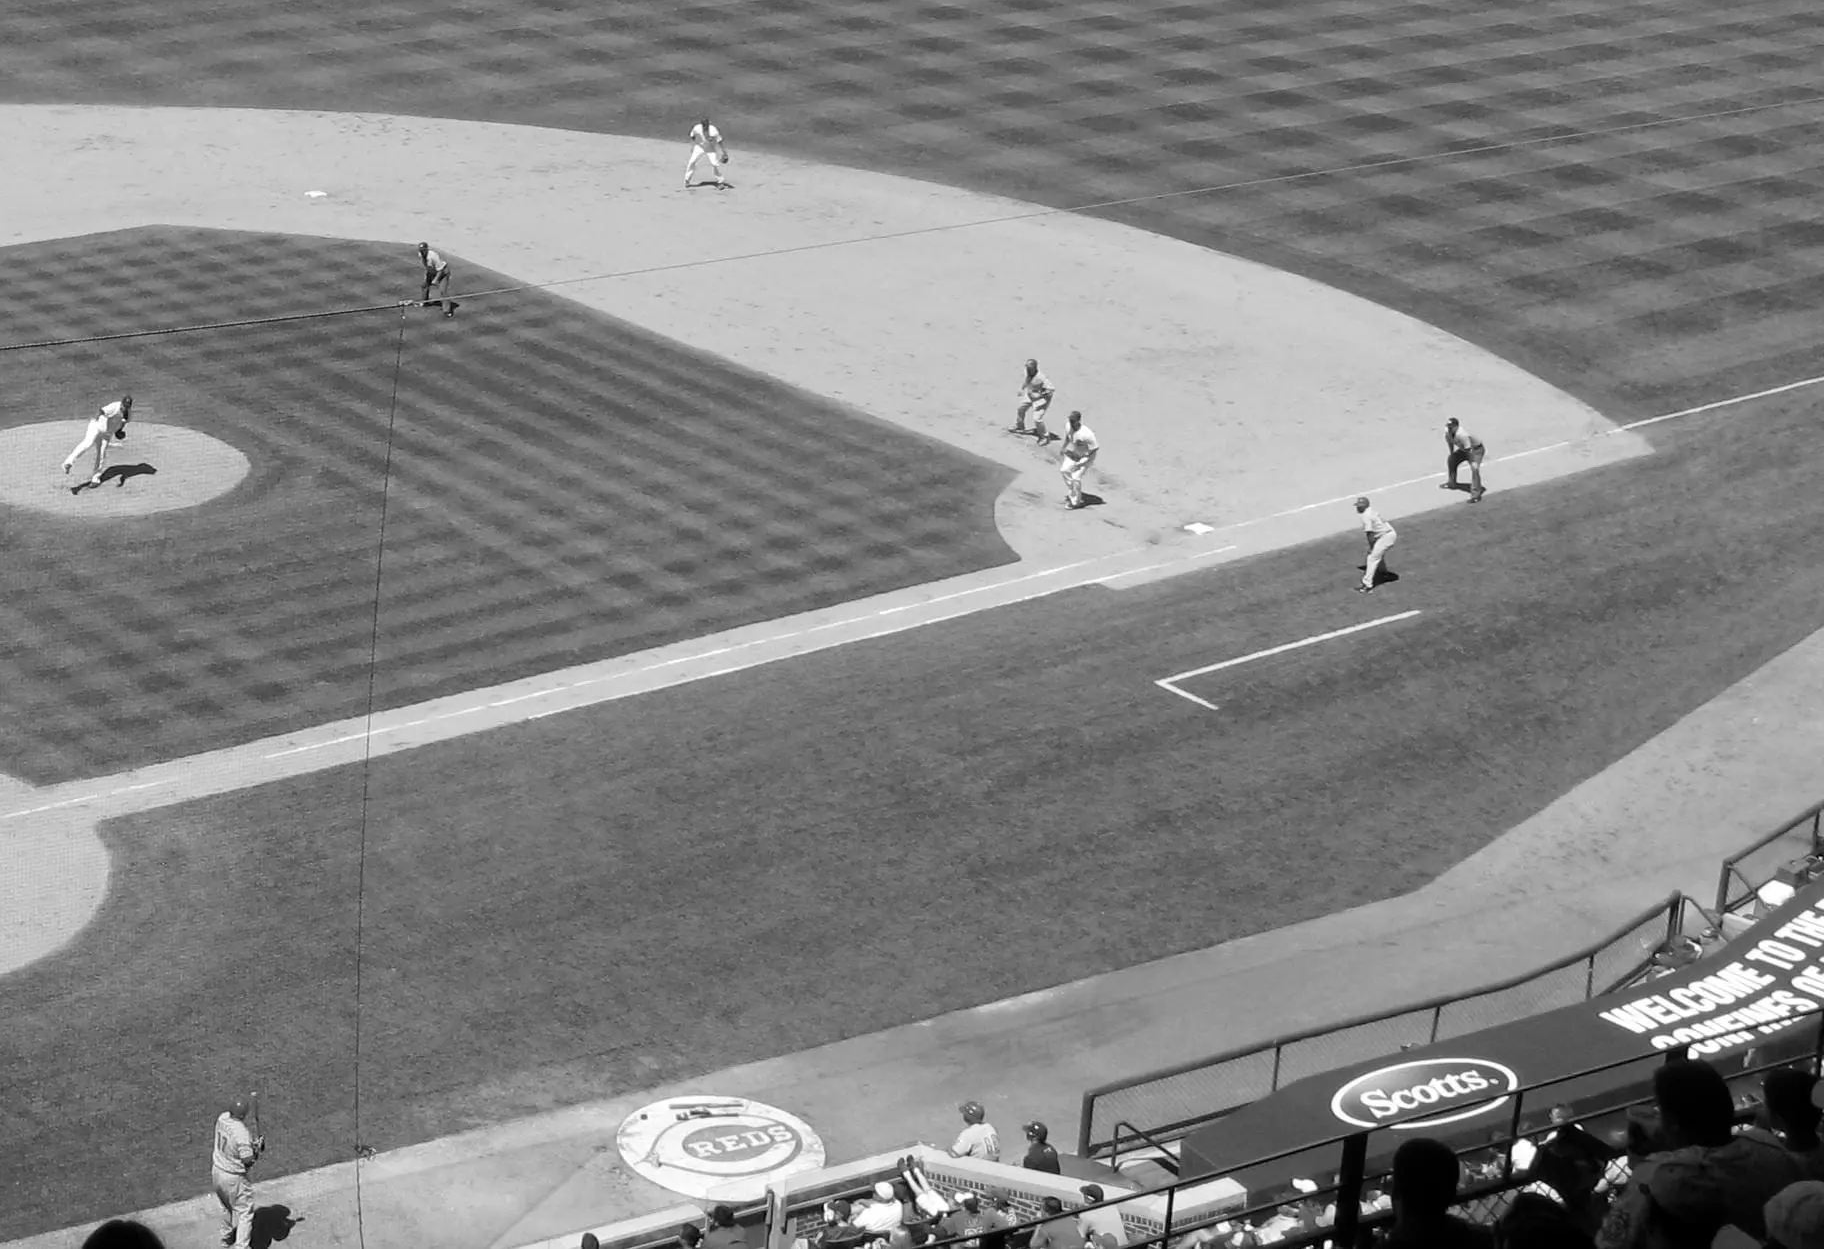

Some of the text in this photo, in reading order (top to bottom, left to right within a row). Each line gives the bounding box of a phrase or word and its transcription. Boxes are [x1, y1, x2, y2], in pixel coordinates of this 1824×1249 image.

[1598, 961, 1776, 1034] WELCOME
[1745, 939, 1806, 971] TO
[687, 1125, 793, 1158] REDS
